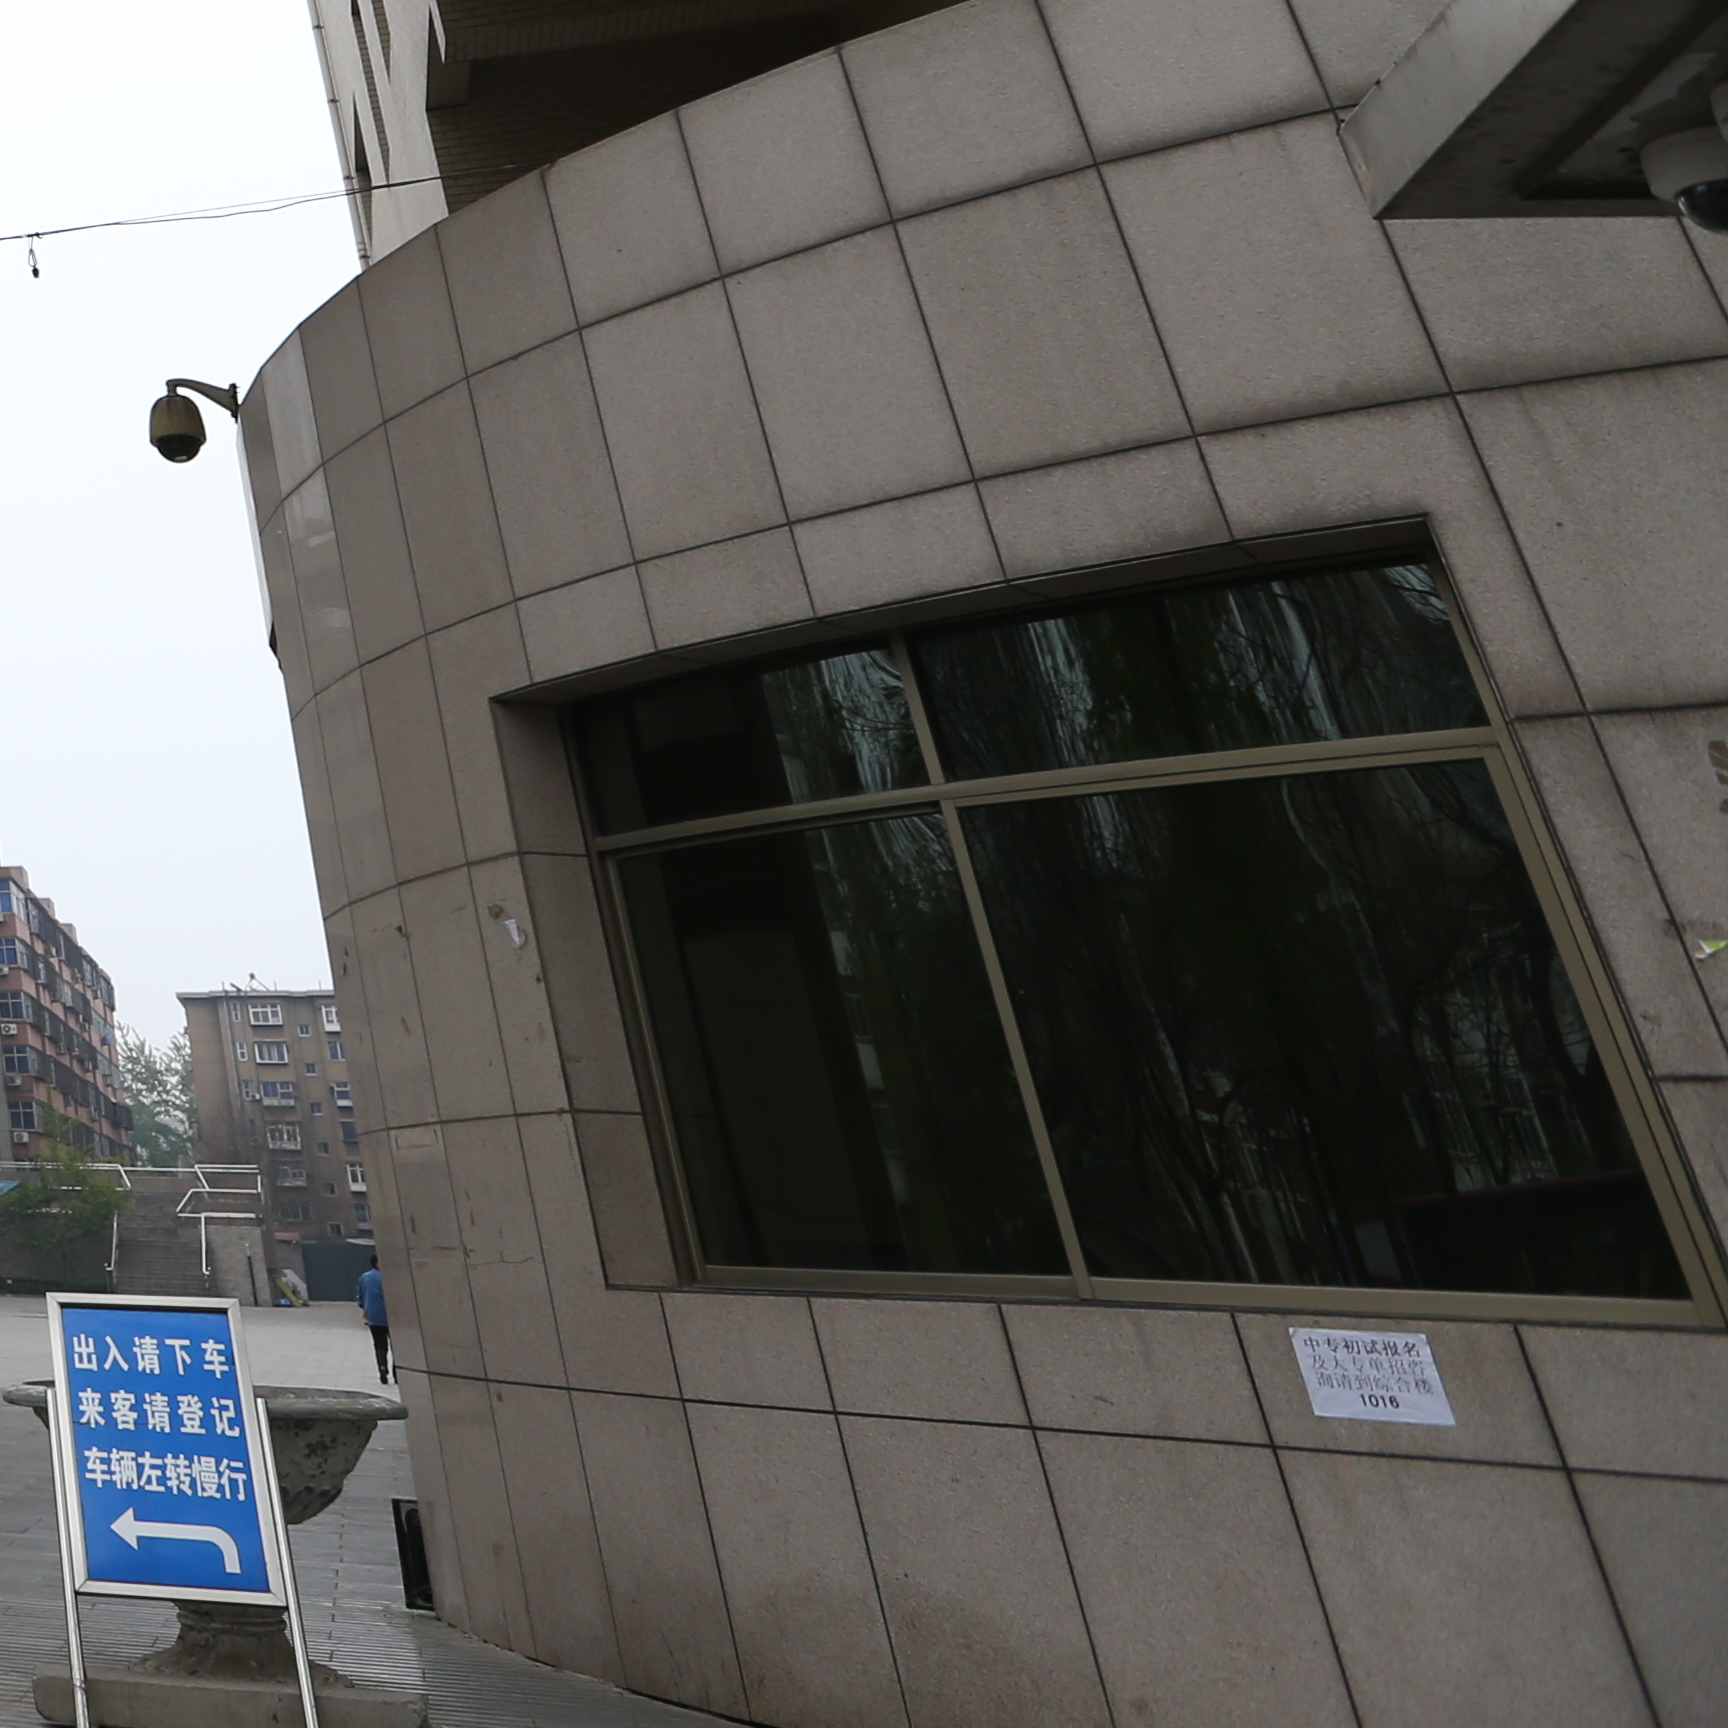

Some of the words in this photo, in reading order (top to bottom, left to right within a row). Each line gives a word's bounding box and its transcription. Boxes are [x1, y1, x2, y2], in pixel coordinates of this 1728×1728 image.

[72, 1333, 230, 1379] 出入请下车
[1303, 1336, 1420, 1357] 中专初试报名
[77, 1387, 241, 1437] 来客请登记
[1360, 1394, 1400, 1409] 1016
[84, 1446, 248, 1501] 车辆左转慢行
